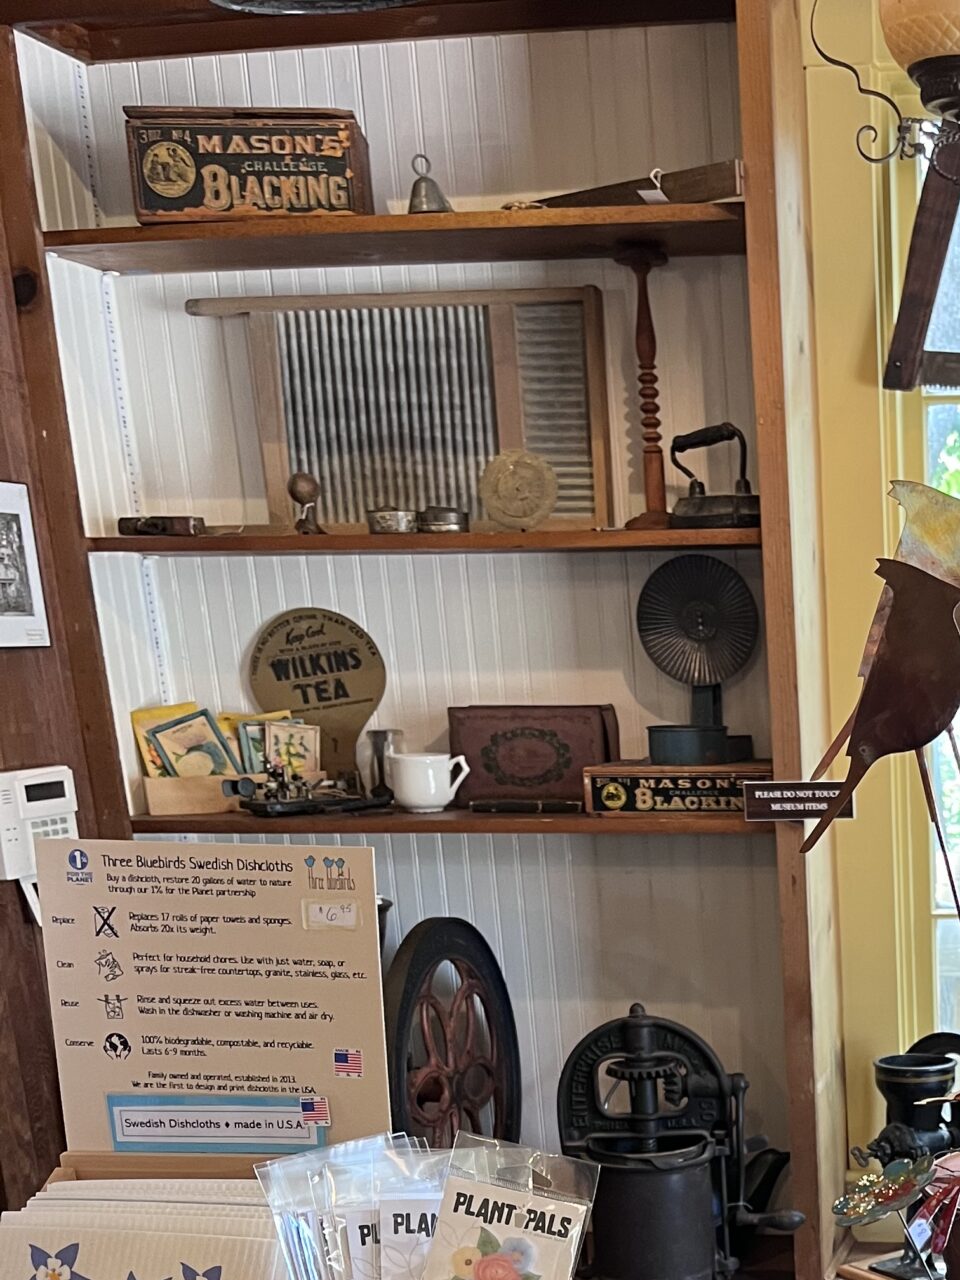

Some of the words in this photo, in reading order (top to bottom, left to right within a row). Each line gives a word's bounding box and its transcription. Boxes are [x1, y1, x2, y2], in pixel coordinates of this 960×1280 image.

[196, 135, 344, 156] MASON'S
[200, 163, 349, 212] BLACKING
[270, 646, 363, 682] WILKINS
[292, 677, 351, 705] TEA
[638, 777, 745, 790] MASON'S
[634, 786, 745, 812] BLACKIN
[754, 790, 783, 800] PLEASE
[782, 790, 796, 799] DO
[795, 789, 813, 799] NOT
[770, 802, 805, 812] MUSEUM
[804, 801, 829, 811] ITEMS
[101, 854, 134, 868] Three
[136, 855, 187, 870] Bluebirds
[188, 856, 234, 870] Swedish
[236, 858, 294, 873] Dishcloths
[106, 873, 120, 884] Buy
[127, 874, 162, 885] dishcloth,
[162, 876, 190, 884] restore
[191, 876, 201, 884] 20
[202, 877, 226, 888] gallons
[226, 877, 235, 886] of
[236, 878, 258, 887] water
[259, 879, 268, 887] to
[269, 879, 293, 887] nature
[51, 915, 76, 925] Replace
[56, 960, 75, 969] Clean
[60, 999, 80, 1008] Reuse
[64, 1038, 96, 1048] Conserve
[124, 1118, 167, 1130] Swedish
[168, 1118, 222, 1131] Dishcloths
[233, 1120, 263, 1130] made
[264, 1119, 275, 1130] in
[453, 1191, 517, 1226] PLANT
[524, 1207, 573, 1240] PALS
